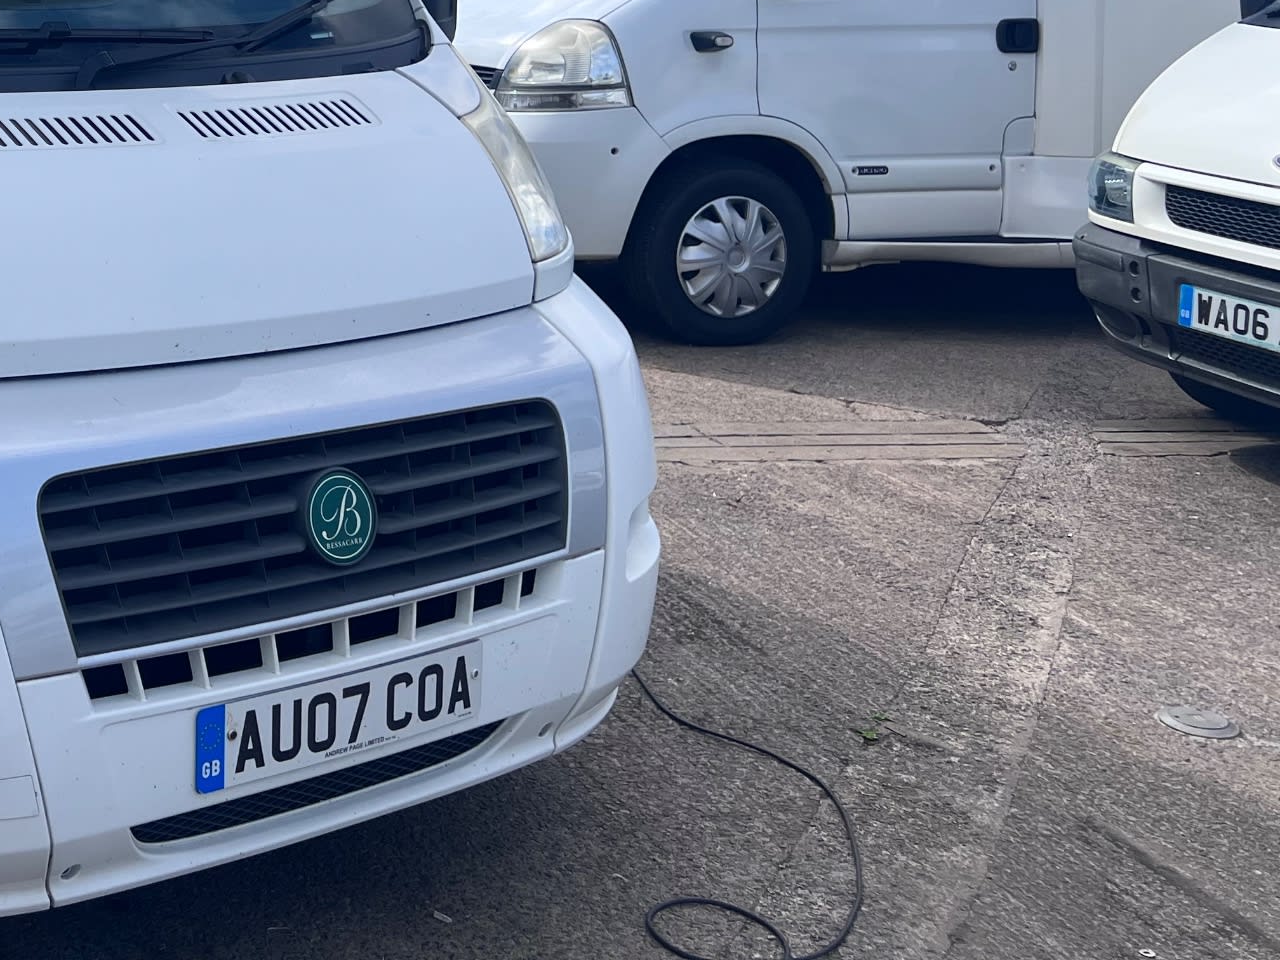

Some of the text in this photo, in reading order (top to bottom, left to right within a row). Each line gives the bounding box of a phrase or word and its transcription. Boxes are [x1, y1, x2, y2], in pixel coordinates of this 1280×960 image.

[1198, 293, 1269, 340] WA06
[327, 538, 363, 550] BESSACARR
[235, 656, 471, 773] AU07 COA
[325, 736, 385, 758] ANDREW PAGE LIMITED
[202, 760, 220, 779] GB
